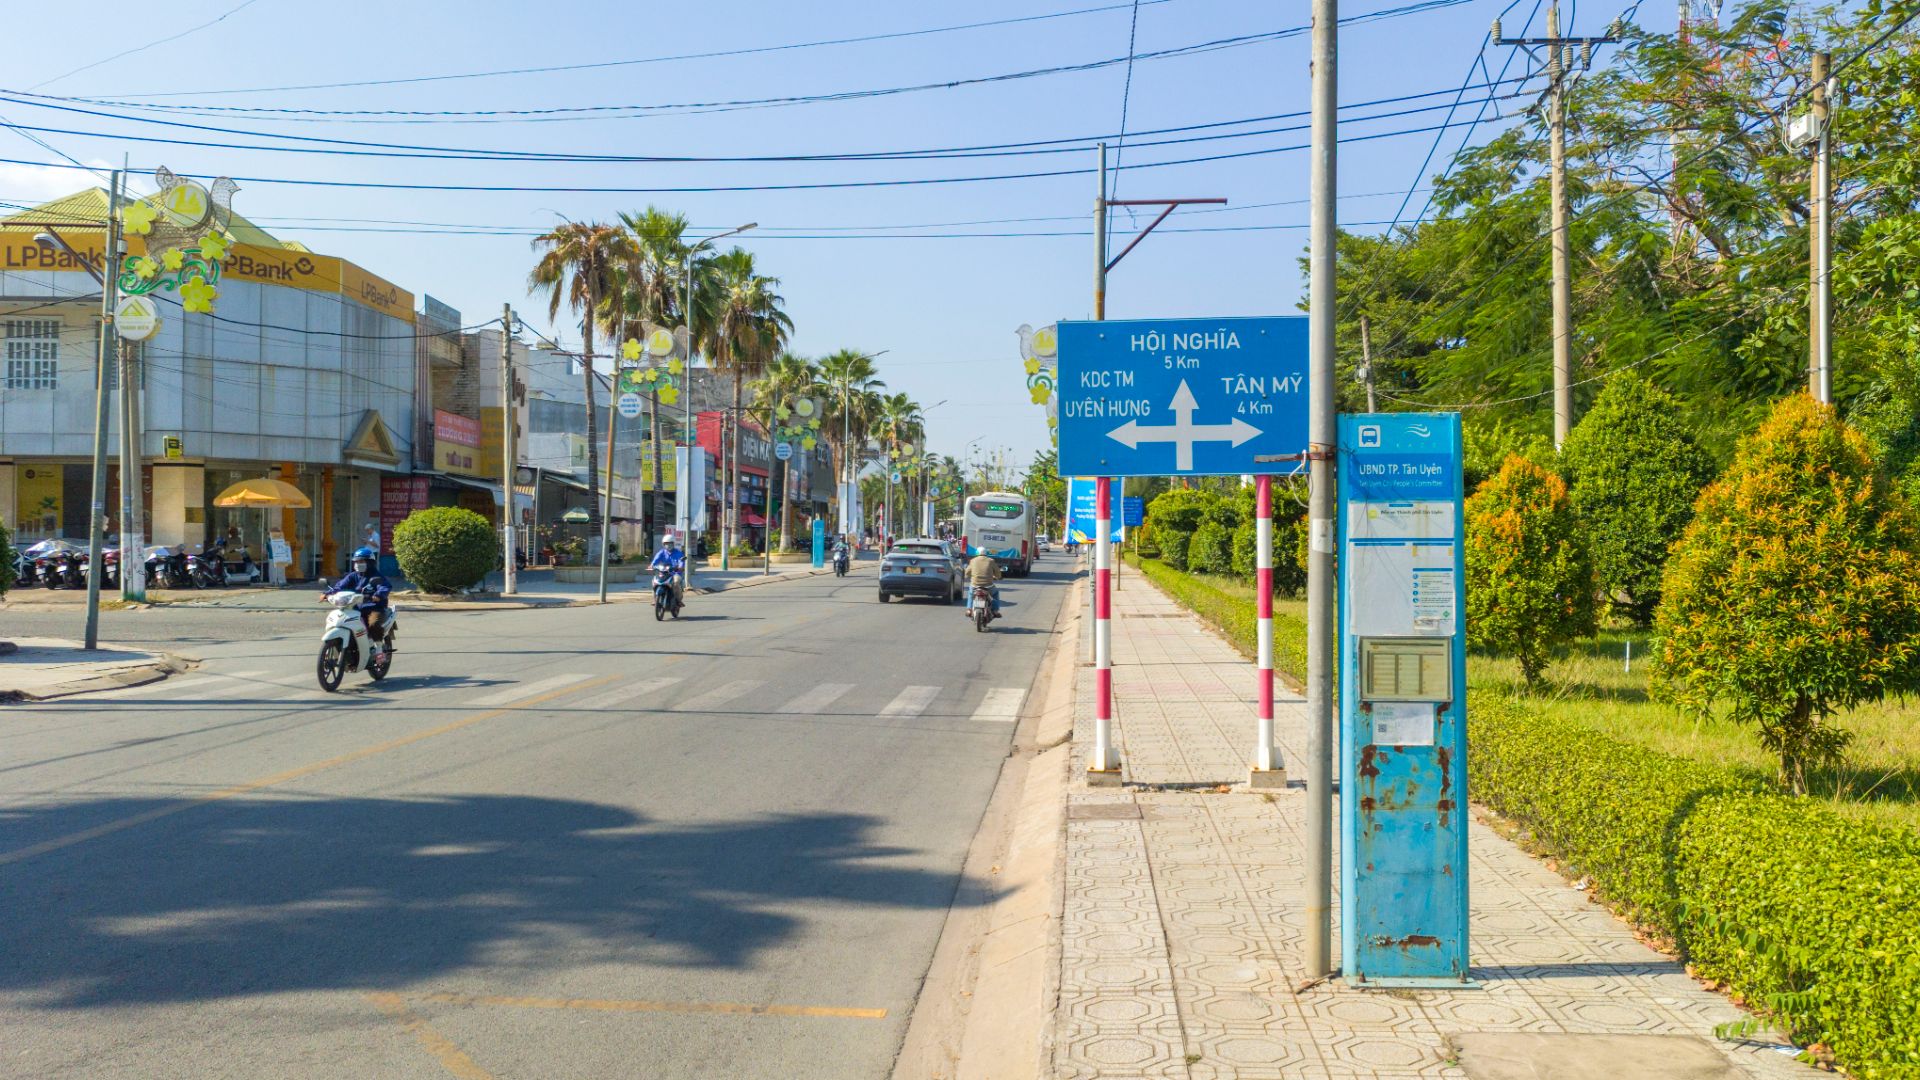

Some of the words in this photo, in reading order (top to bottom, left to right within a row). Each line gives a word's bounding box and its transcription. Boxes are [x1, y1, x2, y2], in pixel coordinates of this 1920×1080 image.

[7, 246, 103, 268] LPBank
[218, 254, 293, 280] PBank
[361, 280, 390, 310] LPBank
[1131, 330, 1166, 355] HỘI
[1173, 328, 1241, 351] NGHĨA
[1164, 355, 1173, 370] 5
[1176, 355, 1200, 369] Km
[1081, 371, 1111, 388] KDC
[1113, 371, 1134, 387] TM
[1221, 373, 1265, 395] TÂN
[1272, 372, 1303, 393] MỸ
[1065, 397, 1104, 418] UYÊN
[1108, 398, 1151, 417] HƯNG
[1237, 401, 1246, 415] 4
[1249, 401, 1273, 414] Km
[1359, 464, 1386, 475] UBND
[1388, 464, 1400, 475] TP.
[1402, 463, 1418, 475] Tân
[1419, 463, 1442, 477] Uyên
